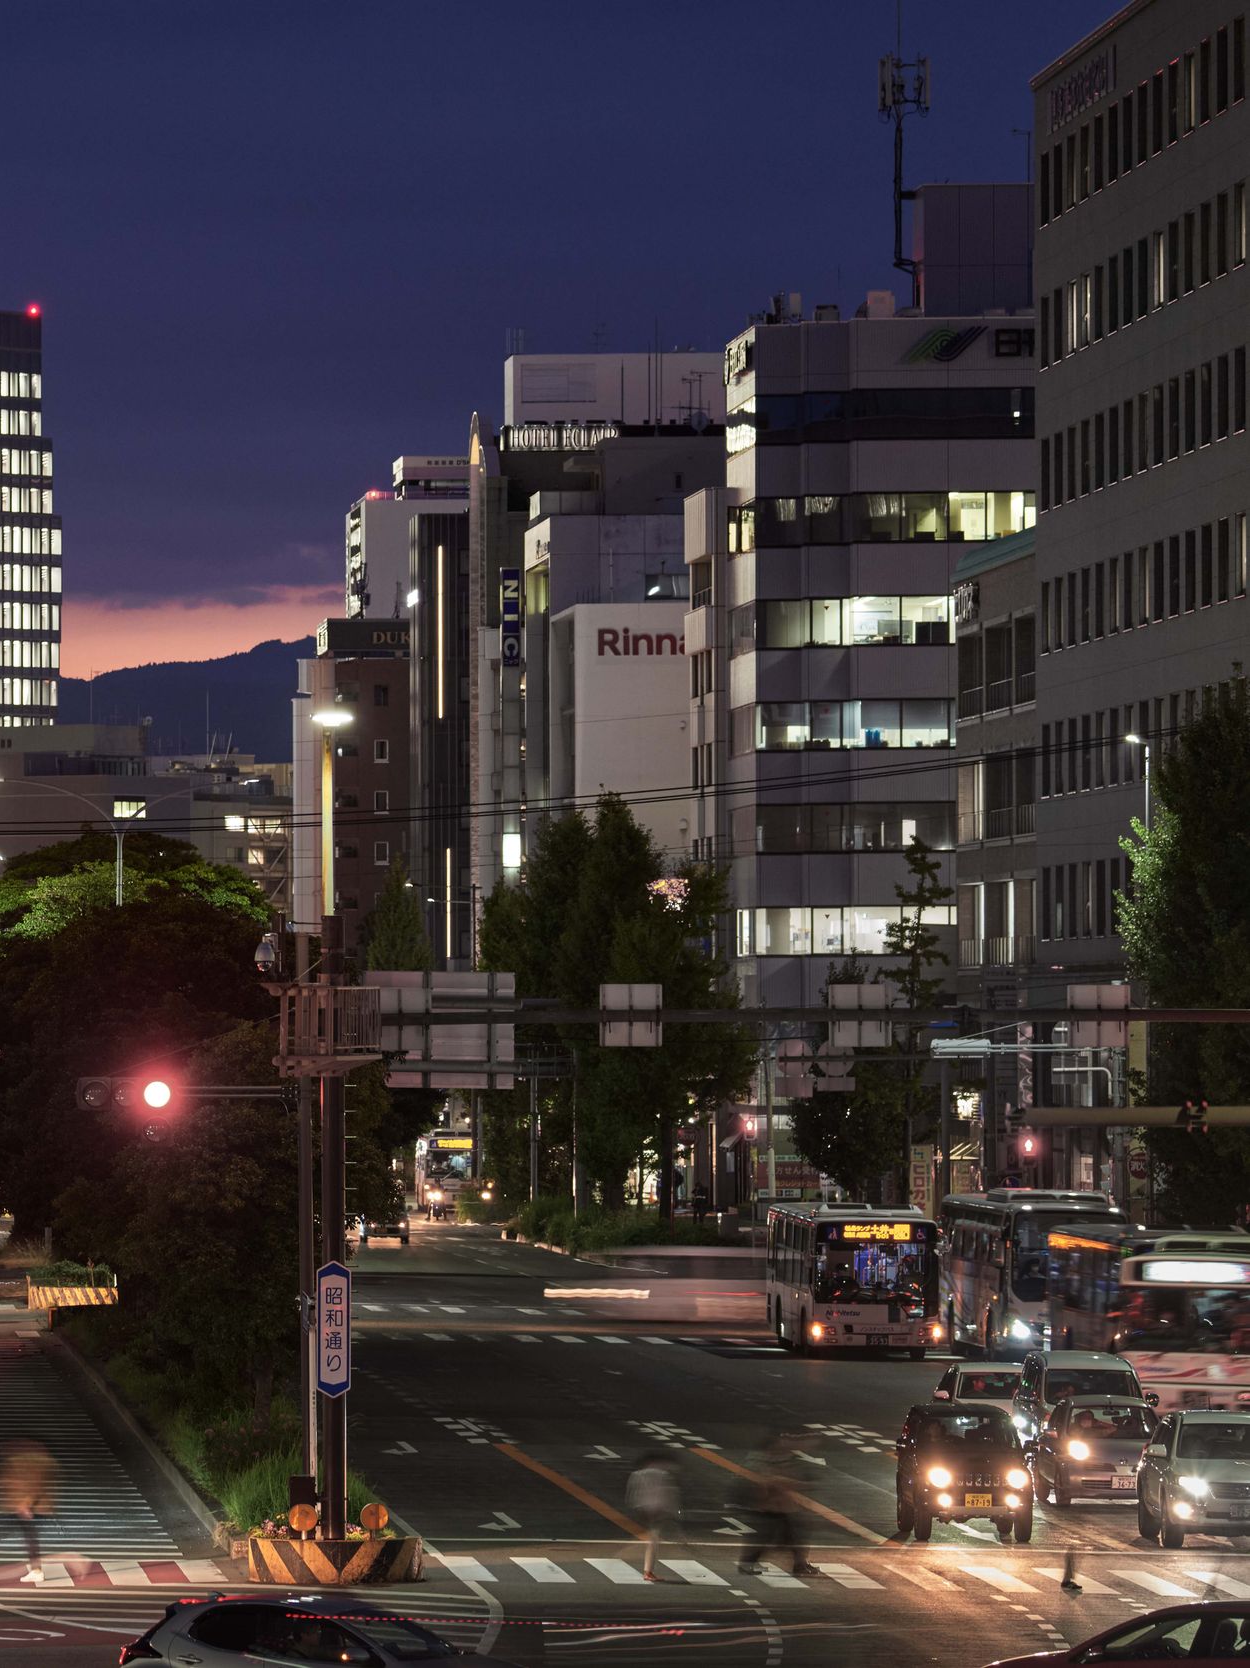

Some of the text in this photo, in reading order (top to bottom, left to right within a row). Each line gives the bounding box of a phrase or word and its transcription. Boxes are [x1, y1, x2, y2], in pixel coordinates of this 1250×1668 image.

[510, 427, 557, 448] HOTEL
[325, 1287, 343, 1372] 昭和通り
